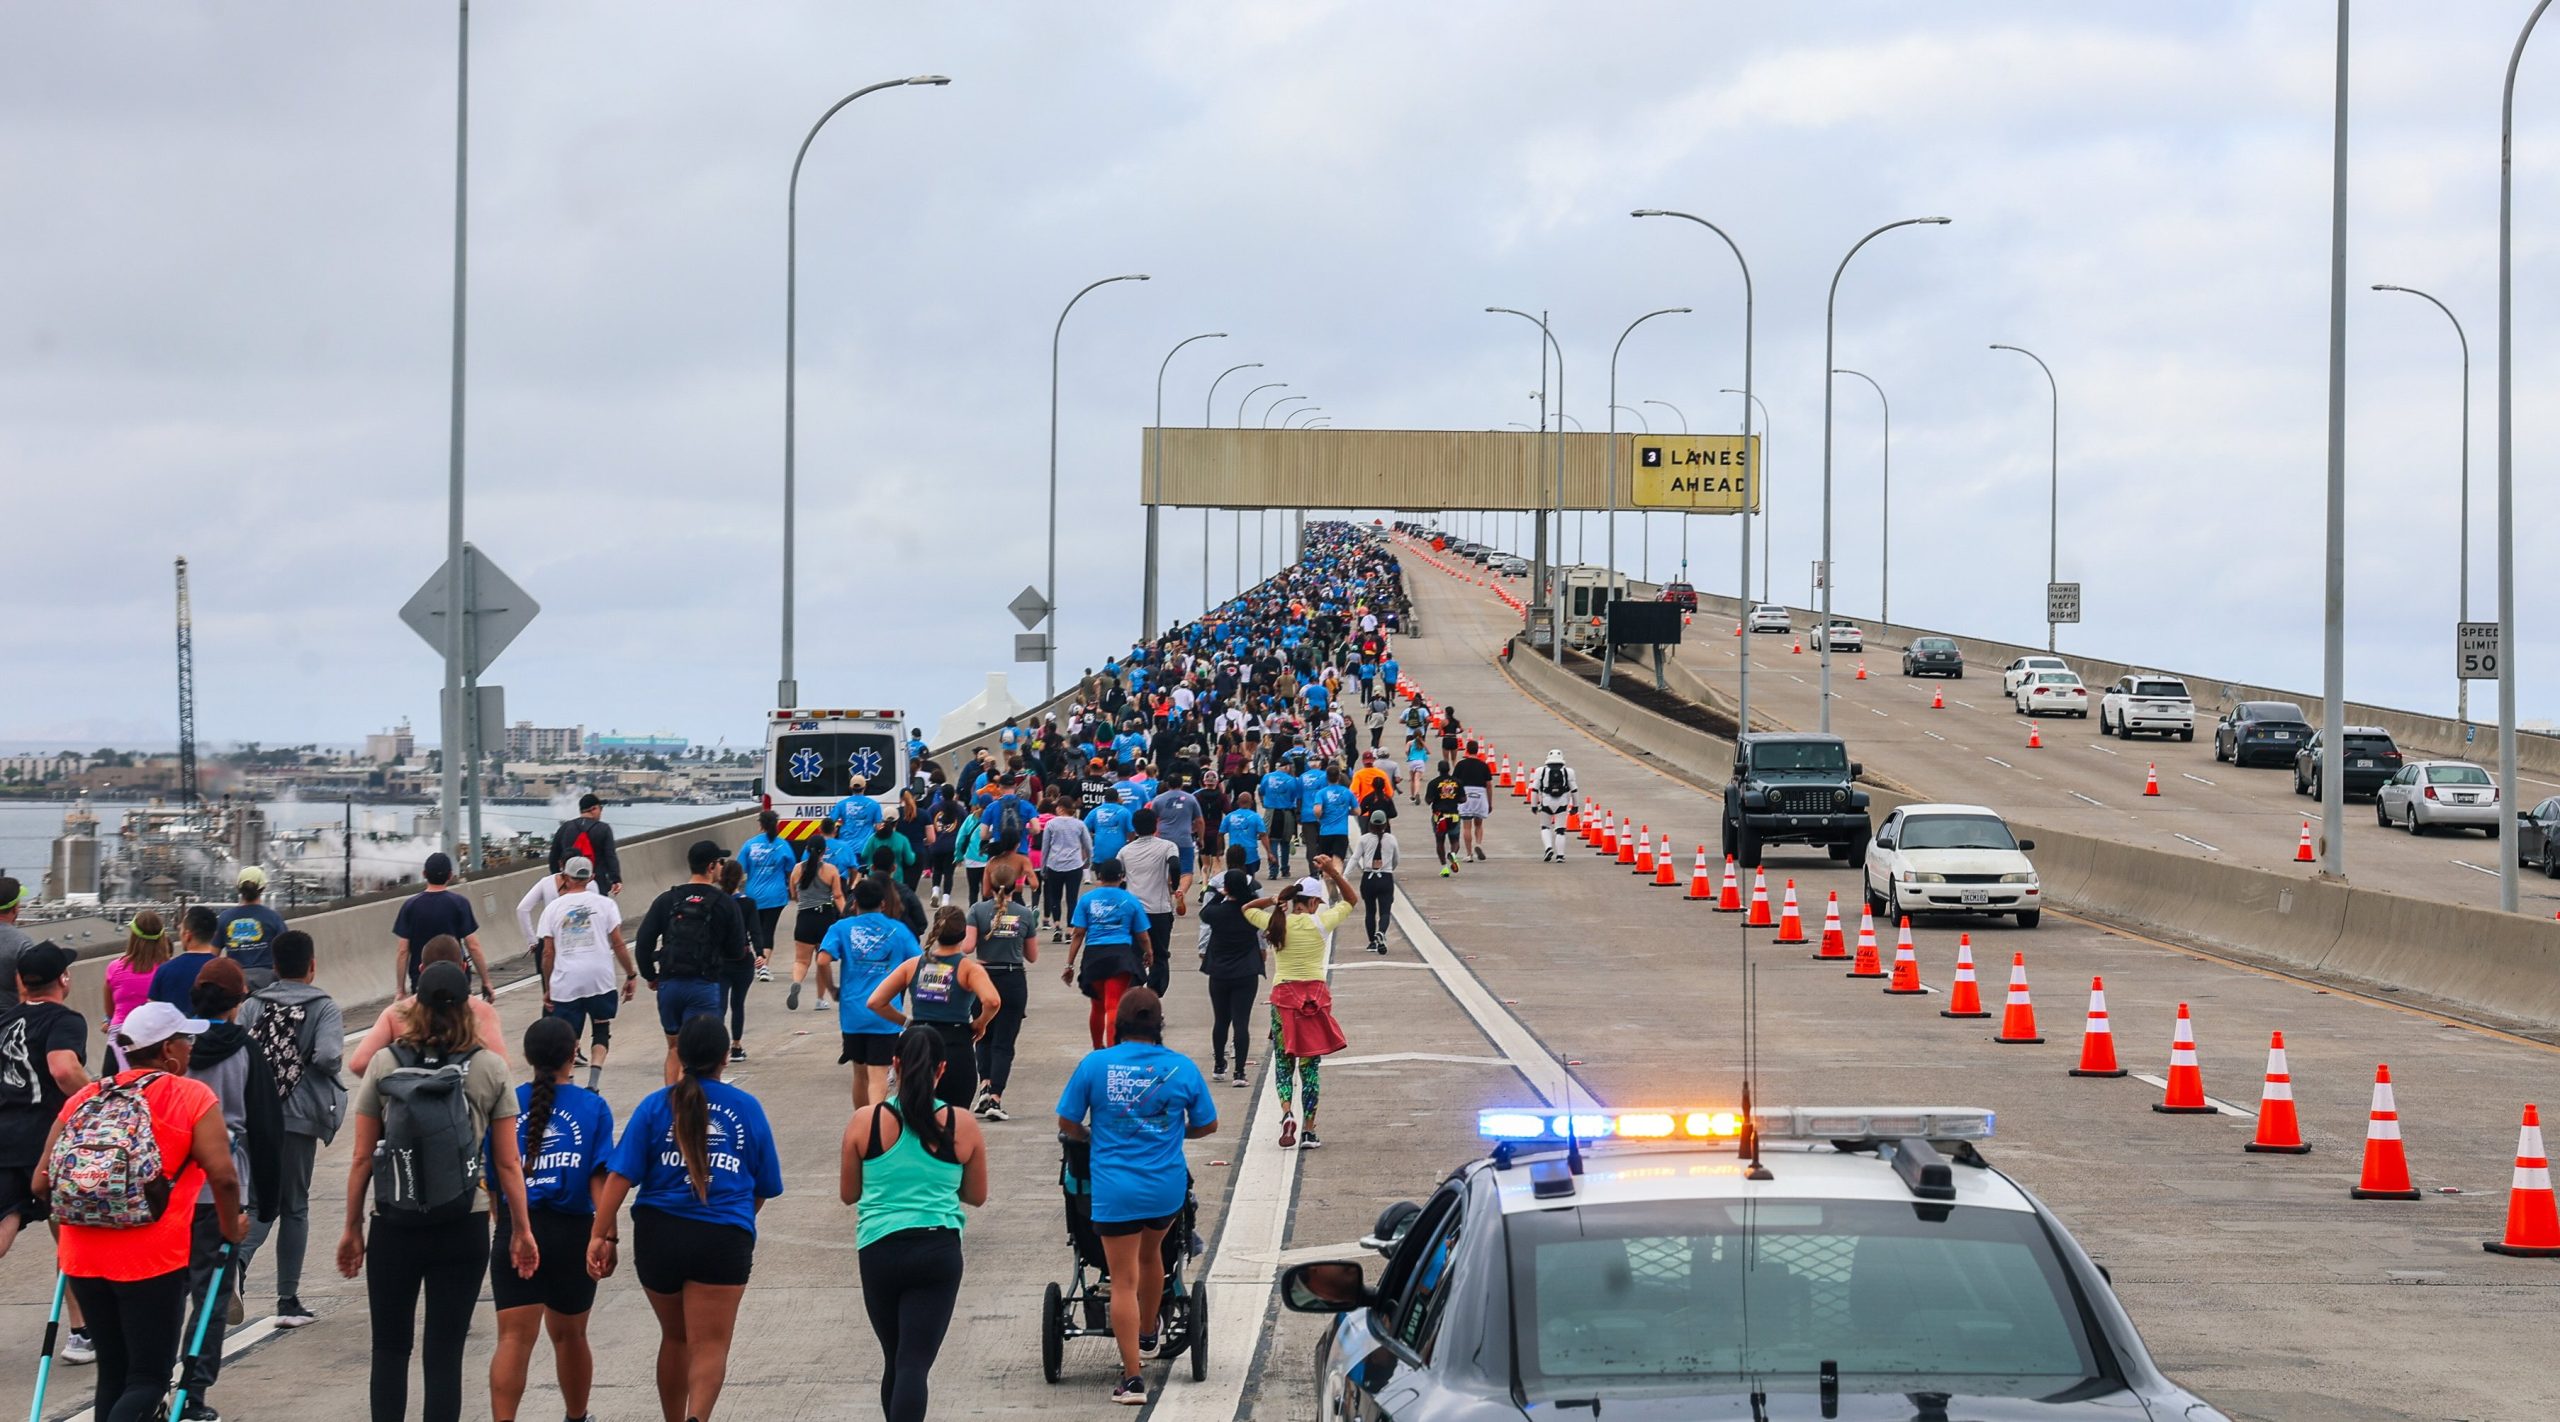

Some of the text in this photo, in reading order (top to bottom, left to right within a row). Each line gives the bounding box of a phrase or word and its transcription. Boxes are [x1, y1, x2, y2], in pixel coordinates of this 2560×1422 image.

[1648, 450, 1746, 466] 3 LANES
[1670, 477, 1745, 492] AHEAD
[2461, 627, 2499, 637] SPEED
[2464, 640, 2498, 650] LIMIT
[2465, 655, 2496, 671] 50
[795, 806, 833, 818] AMBU
[1107, 1070, 1131, 1078] BAY
[1107, 1079, 1151, 1087] BRIDGE
[1107, 1094, 1140, 1103] WALK
[569, 1121, 582, 1146] STARS
[723, 1108, 738, 1122] ALL
[735, 1124, 745, 1150] STARS
[661, 1151, 741, 1174] VOLTEER
